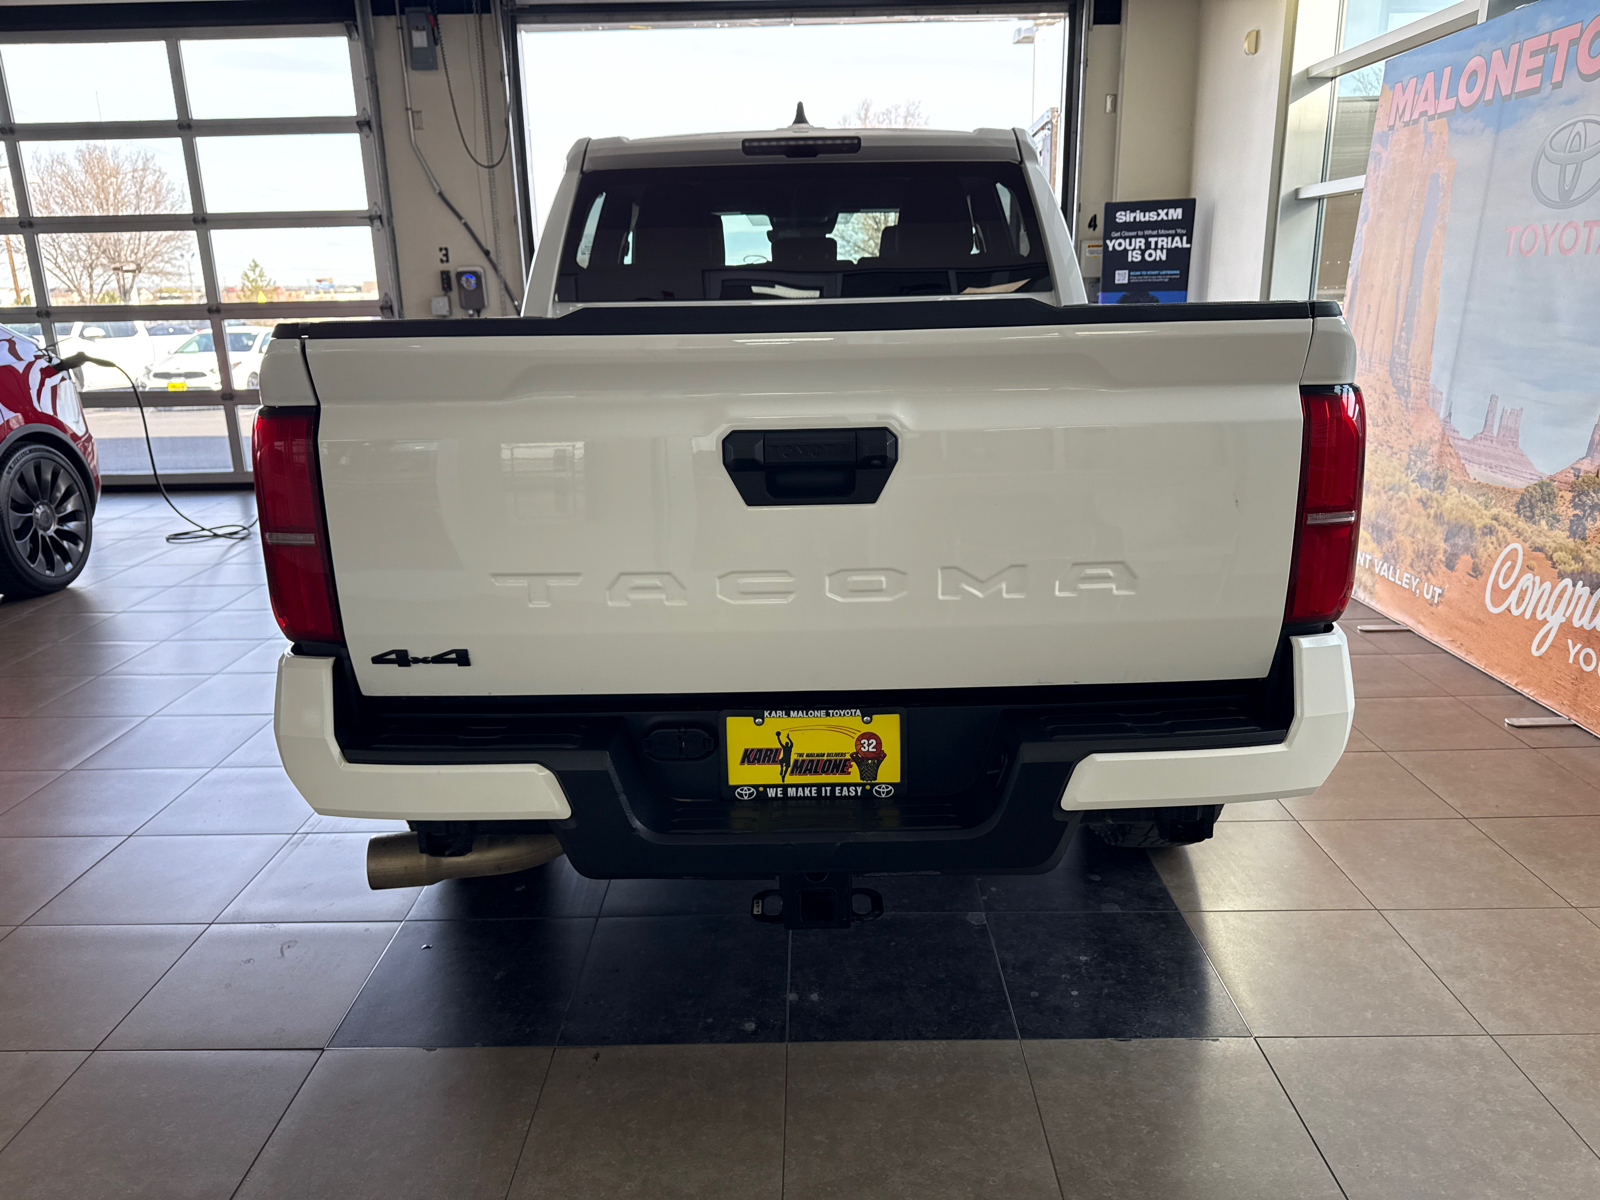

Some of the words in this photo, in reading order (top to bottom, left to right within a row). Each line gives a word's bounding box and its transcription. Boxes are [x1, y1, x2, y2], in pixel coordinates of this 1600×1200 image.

[1088, 214, 1098, 231] 4
[1115, 208, 1183, 223] SiriusXM
[1106, 237, 1145, 251] YOUR
[1148, 236, 1191, 249] TRIAL
[1505, 220, 1600, 257] TOYOT
[439, 247, 449, 263] 3
[1128, 250, 1142, 262] IS
[1144, 249, 1167, 261] ON
[767, 444, 853, 459] TOYOTA
[489, 560, 1138, 607] TACOMA
[1374, 558, 1420, 597] VALLEY,
[1423, 582, 1443, 604] UT
[371, 649, 471, 667] 4x4
[1567, 638, 1600, 677] YO
[764, 710, 788, 718] KARL
[790, 709, 826, 718] MALONE
[828, 709, 861, 717] TOYOTA
[860, 739, 877, 752] 32
[740, 748, 782, 765] KARL
[789, 758, 853, 776] MALONE
[767, 787, 783, 797] WE
[787, 787, 818, 797] MAKE
[822, 786, 832, 796] IT
[835, 786, 863, 796] EASY
